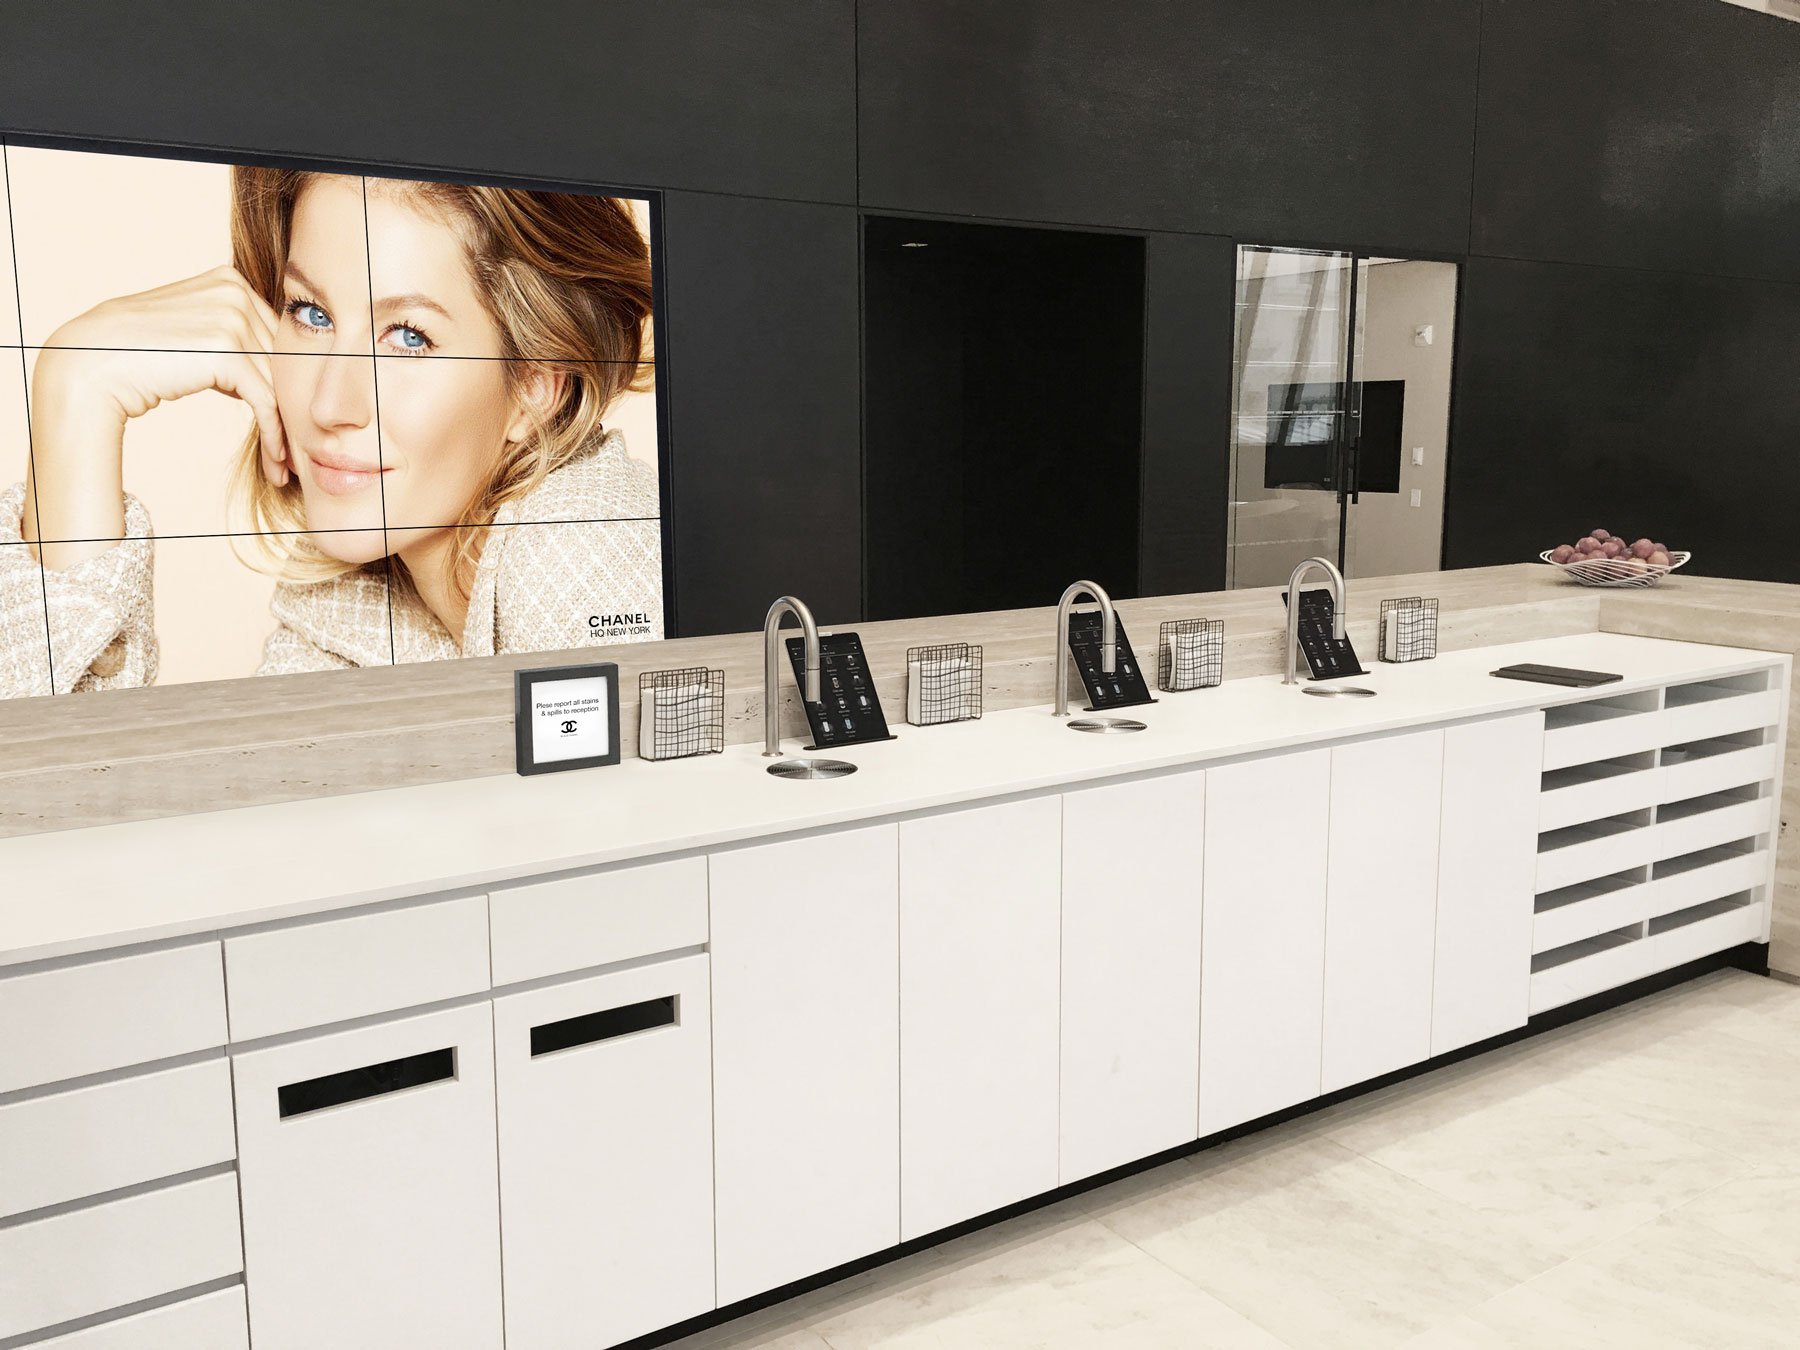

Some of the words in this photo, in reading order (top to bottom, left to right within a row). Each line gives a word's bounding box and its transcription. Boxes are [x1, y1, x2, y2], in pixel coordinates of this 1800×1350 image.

[589, 613, 651, 627] CHANEL
[590, 629, 605, 638] HQ
[606, 628, 626, 637] NEW
[628, 626, 651, 635] YORK
[554, 700, 572, 708] report
[547, 709, 562, 717] spills
